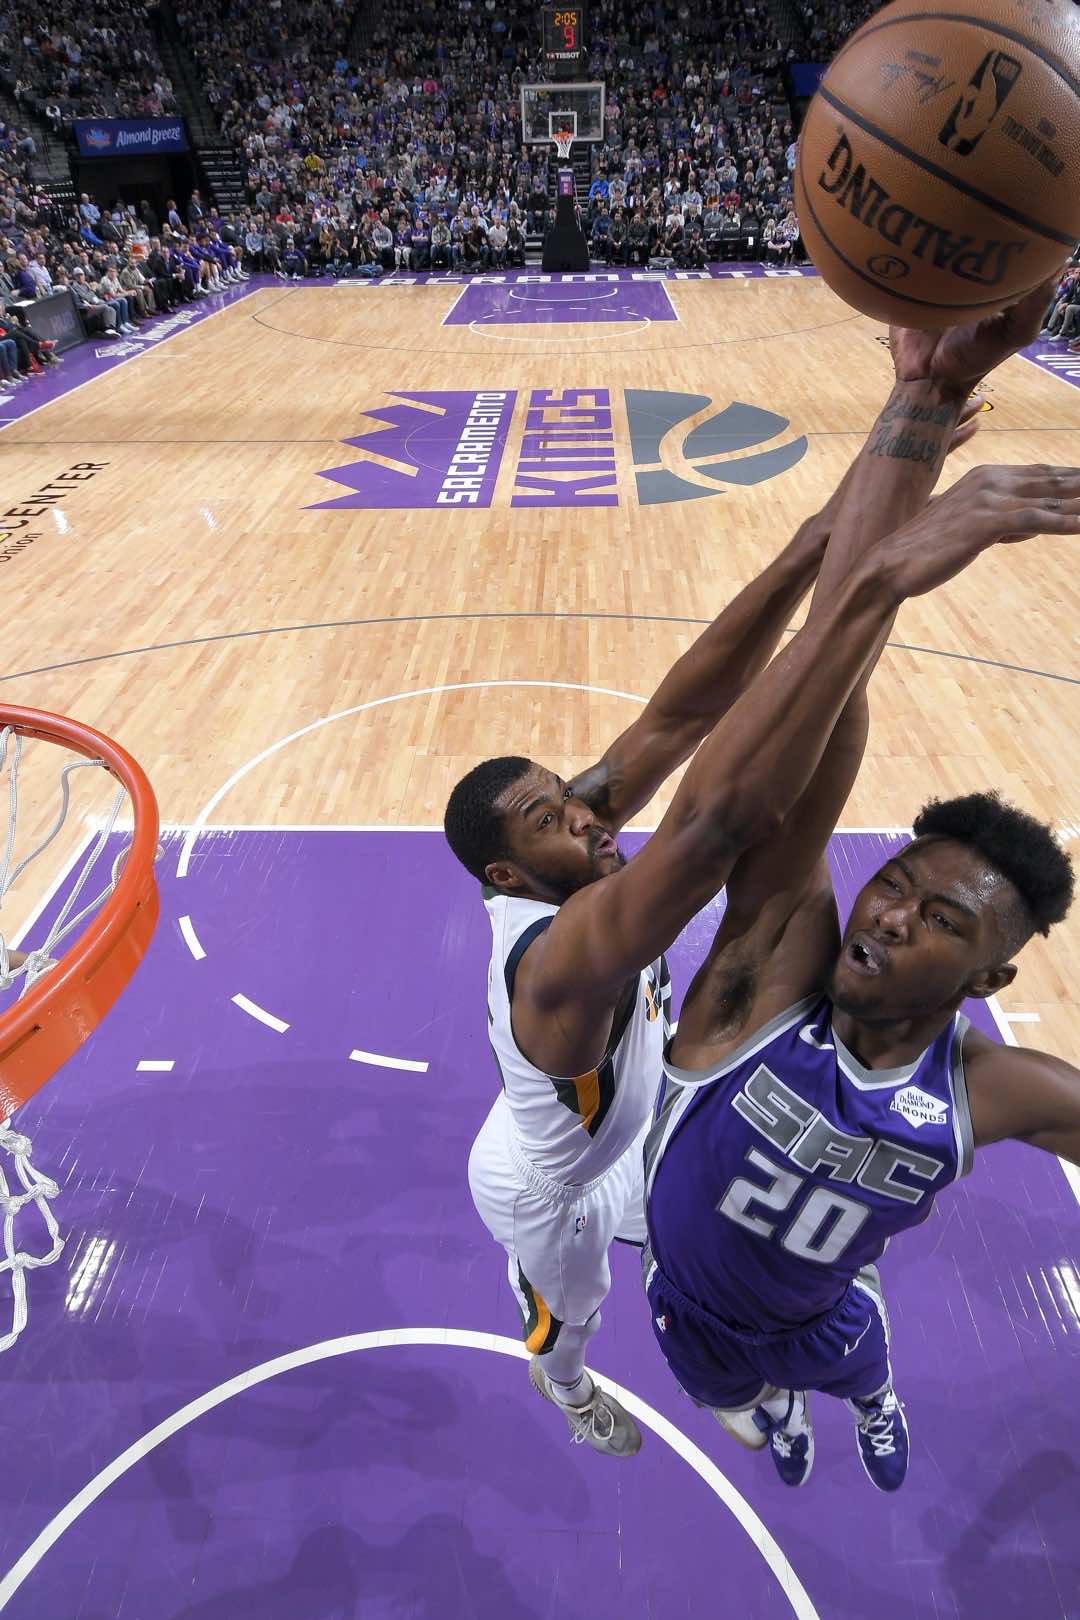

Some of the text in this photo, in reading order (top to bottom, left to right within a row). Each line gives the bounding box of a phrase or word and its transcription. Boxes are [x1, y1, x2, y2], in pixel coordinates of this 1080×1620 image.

[554, 12, 577, 26] 2:05
[116, 127, 180, 147] Almond Breeze
[818, 133, 1029, 286] SPALDING
[333, 269, 803, 287] SACRAMENTO
[436, 392, 507, 504] SACRAMENTO
[511, 388, 620, 508] KINGS
[731, 1063, 944, 1204] SAC
[891, 1102, 945, 1123] ALMONDS
[899, 1095, 935, 1110] DIAMOND
[716, 1146, 871, 1263] 20
